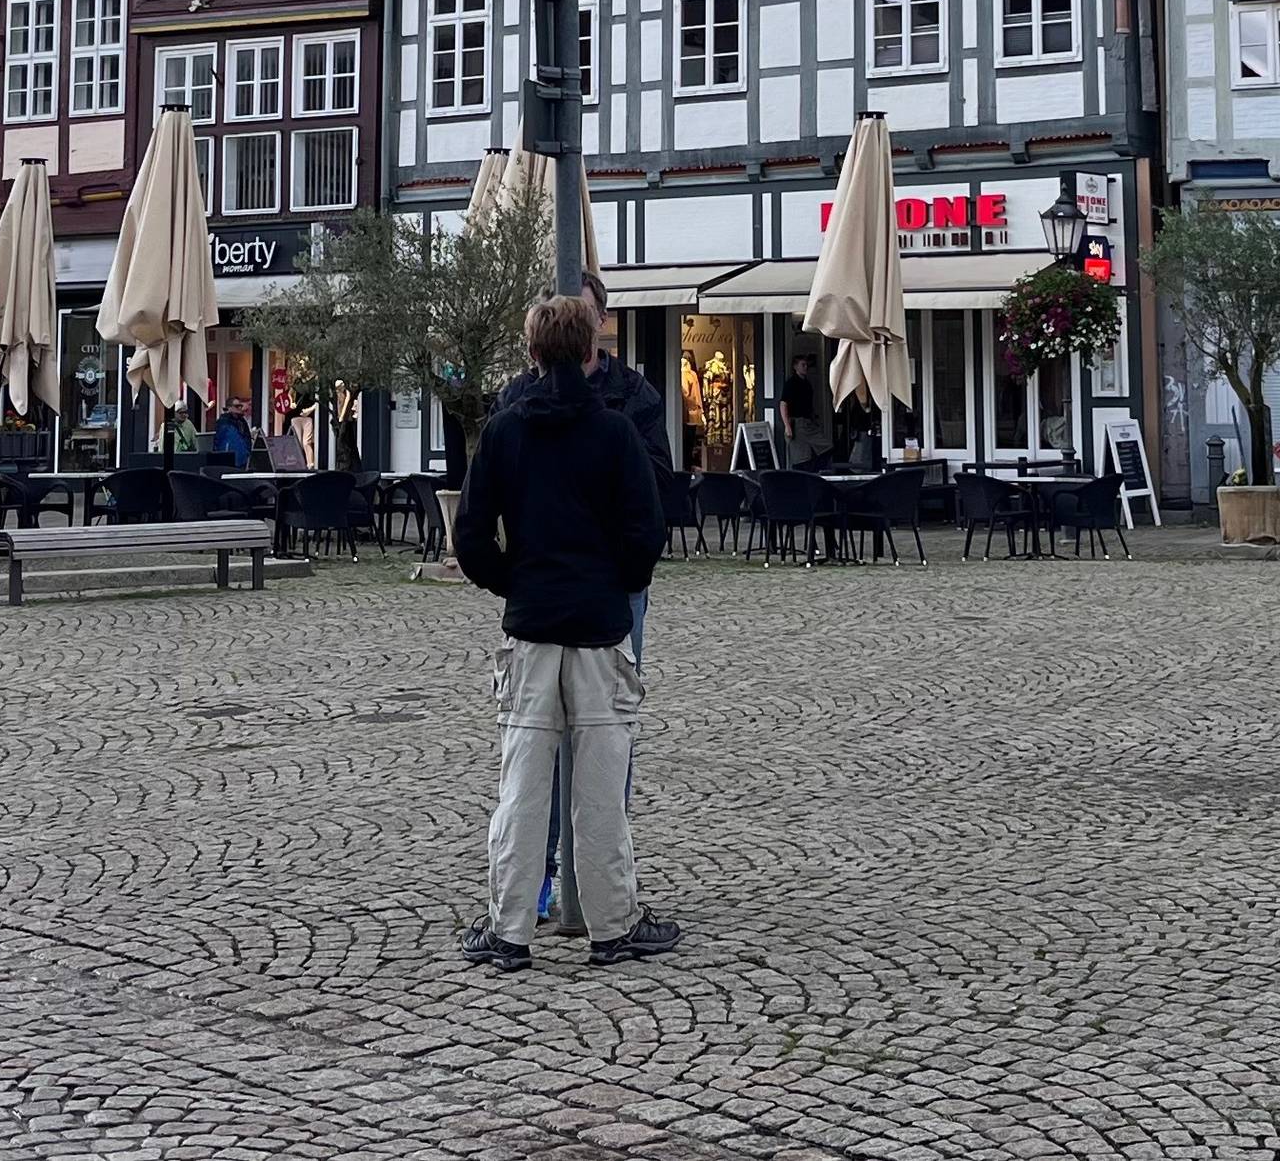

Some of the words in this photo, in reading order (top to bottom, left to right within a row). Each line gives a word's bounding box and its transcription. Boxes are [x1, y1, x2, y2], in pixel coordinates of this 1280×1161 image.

[208, 233, 276, 269] iberty
[1088, 240, 1103, 258] sky
[222, 264, 254, 273] woman
[81, 345, 100, 353] CITY
